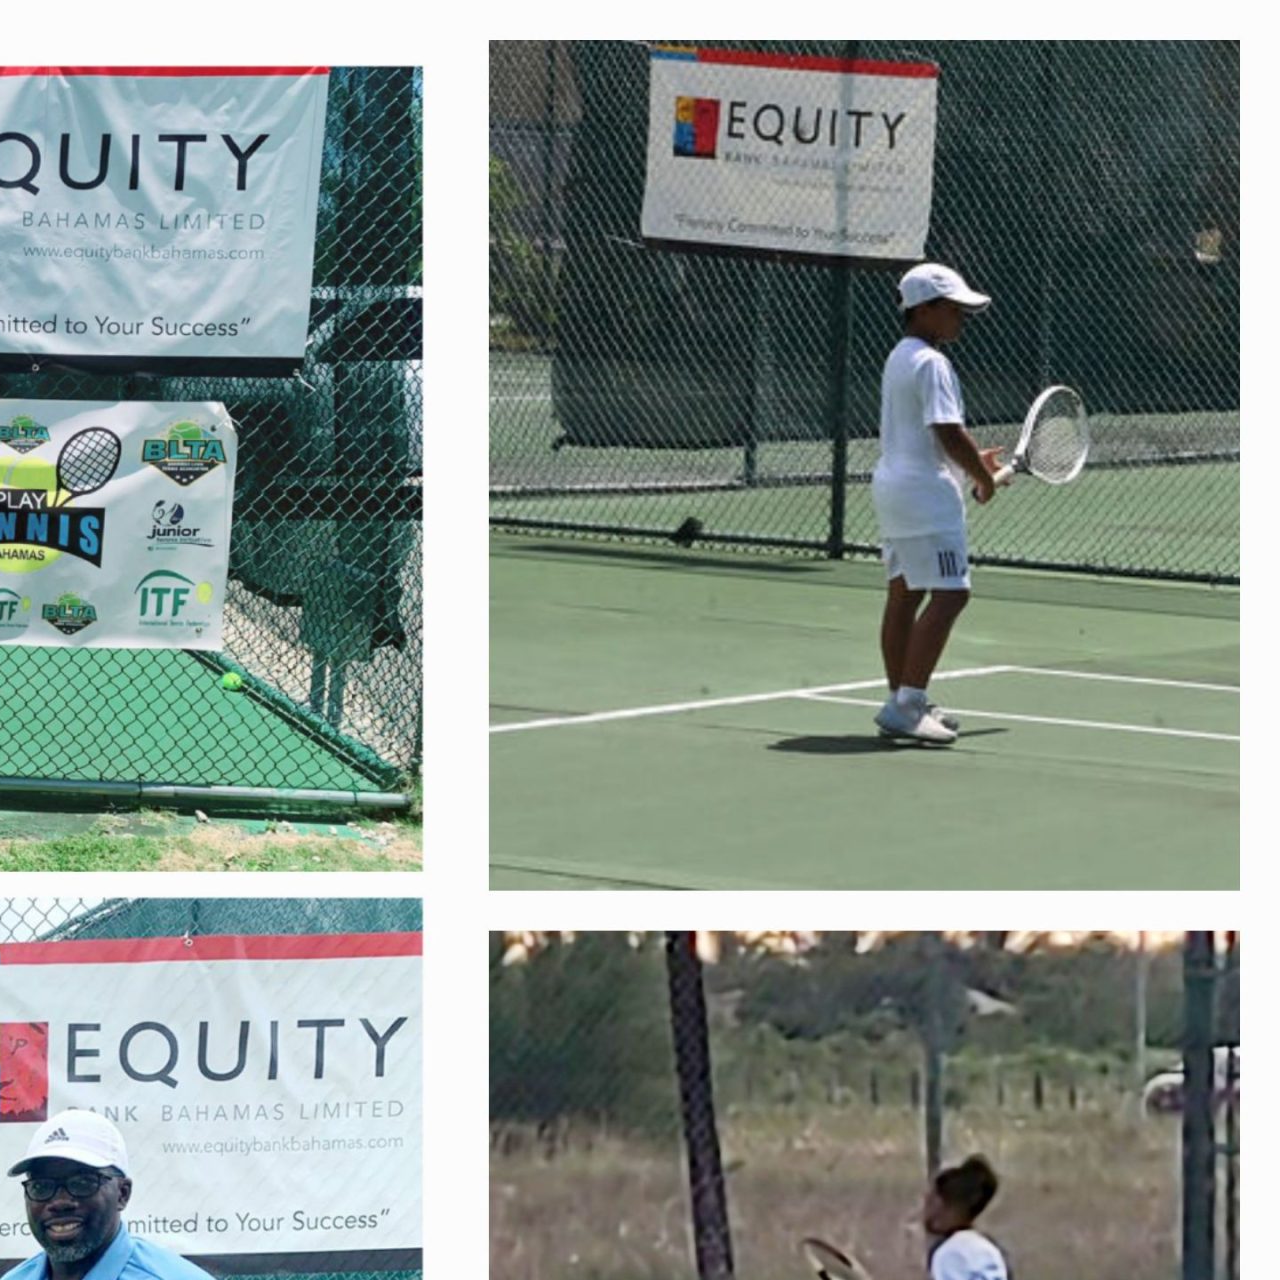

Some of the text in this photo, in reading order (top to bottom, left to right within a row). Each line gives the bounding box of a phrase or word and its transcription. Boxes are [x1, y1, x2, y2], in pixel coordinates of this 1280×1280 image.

[727, 101, 906, 149] EQUITY
[22, 211, 145, 229] BAHAMAS
[160, 213, 265, 230] LIMITED
[23, 244, 264, 262] www.equitybankbahamas.com
[65, 317, 88, 334] to
[95, 316, 144, 335] Your
[142, 440, 227, 462] BLTA
[147, 524, 200, 539] junior
[42, 604, 97, 619] BLTA
[140, 588, 190, 616] ITF
[66, 1017, 408, 1088] EQUITY
[161, 1102, 284, 1122] BAHAMAS
[299, 1100, 404, 1120] LIMITED
[162, 1134, 404, 1156] www.equitybankbahamas.com
[207, 1215, 228, 1232] to
[235, 1212, 284, 1232] Your
